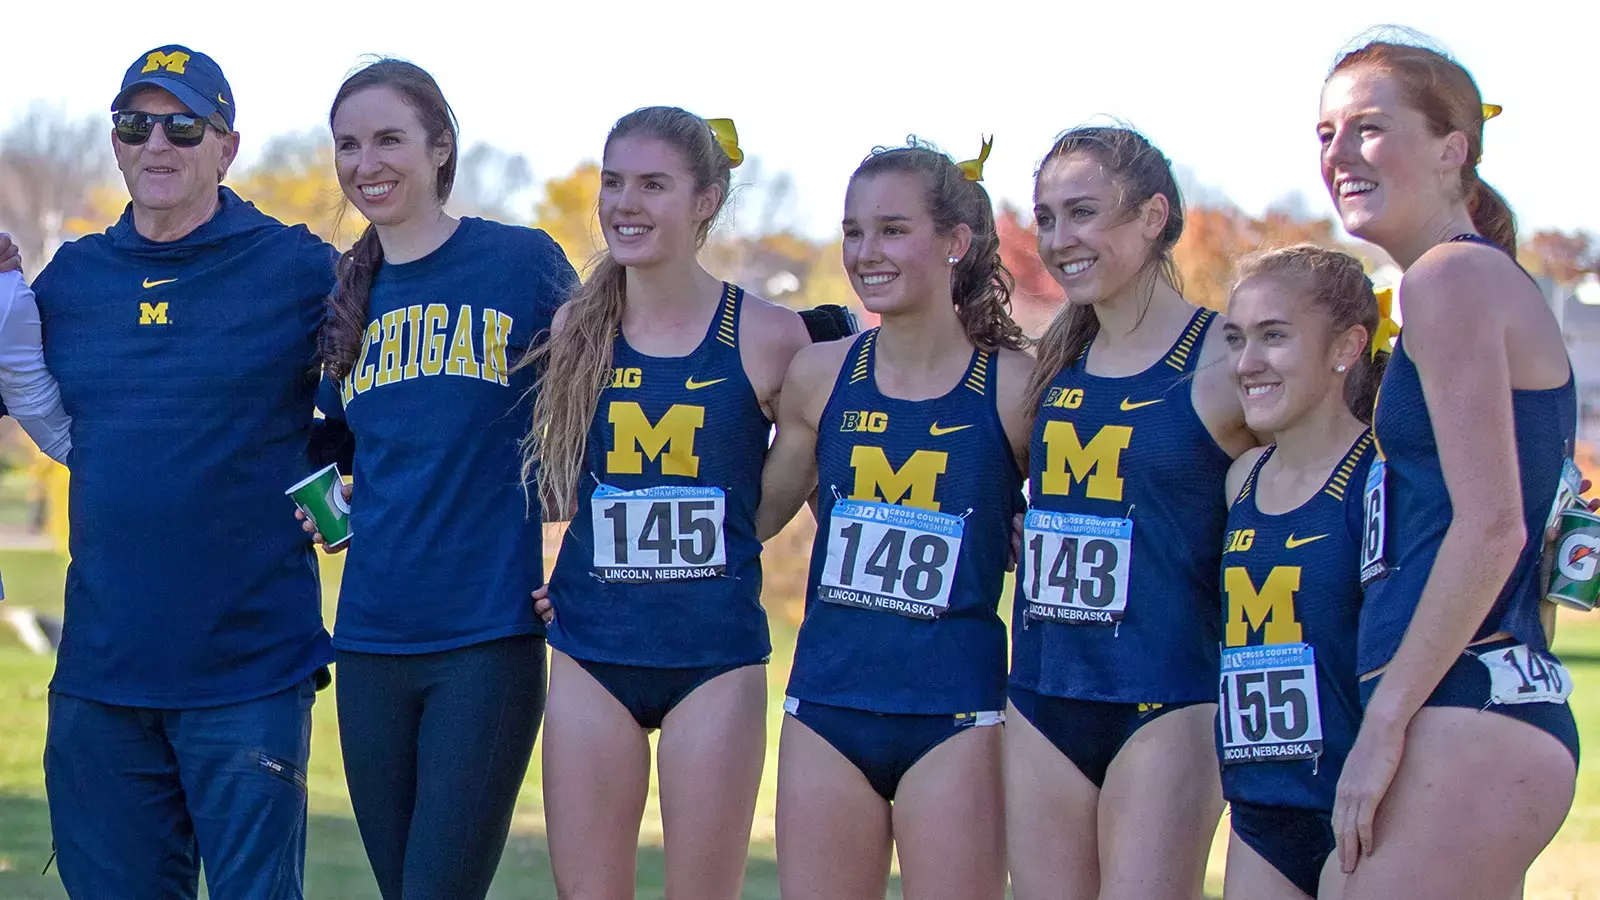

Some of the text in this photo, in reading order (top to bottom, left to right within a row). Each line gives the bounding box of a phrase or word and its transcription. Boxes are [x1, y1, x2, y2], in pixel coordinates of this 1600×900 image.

[141, 51, 190, 75] M
[140, 302, 168, 325] M
[340, 303, 514, 411] CHIGAN
[607, 401, 705, 478] M
[1042, 420, 1134, 502] M
[848, 445, 948, 512] M
[648, 487, 715, 497] CHAMPIONSHIPS
[887, 516, 954, 535] CHAMPIONSHIPS
[889, 508, 956, 526] CROSS COUNTRY
[1085, 518, 1122, 528] COUNTRY
[604, 501, 716, 565] 145
[1061, 525, 1121, 537] CHAMPIONSHIPS
[840, 522, 950, 601] 148
[1029, 533, 1119, 608] 143
[1558, 533, 1600, 582] G
[604, 568, 717, 580] LINCOLN, NEBRASKA
[828, 588, 935, 617] LINCOLN, NEBRASKA
[1057, 608, 1113, 622] NEBRASKA
[1225, 566, 1303, 647] M
[1242, 647, 1304, 659] CROSS COUNTRY
[1221, 669, 1309, 743] 155
[1252, 744, 1313, 757] NEBRASKA
